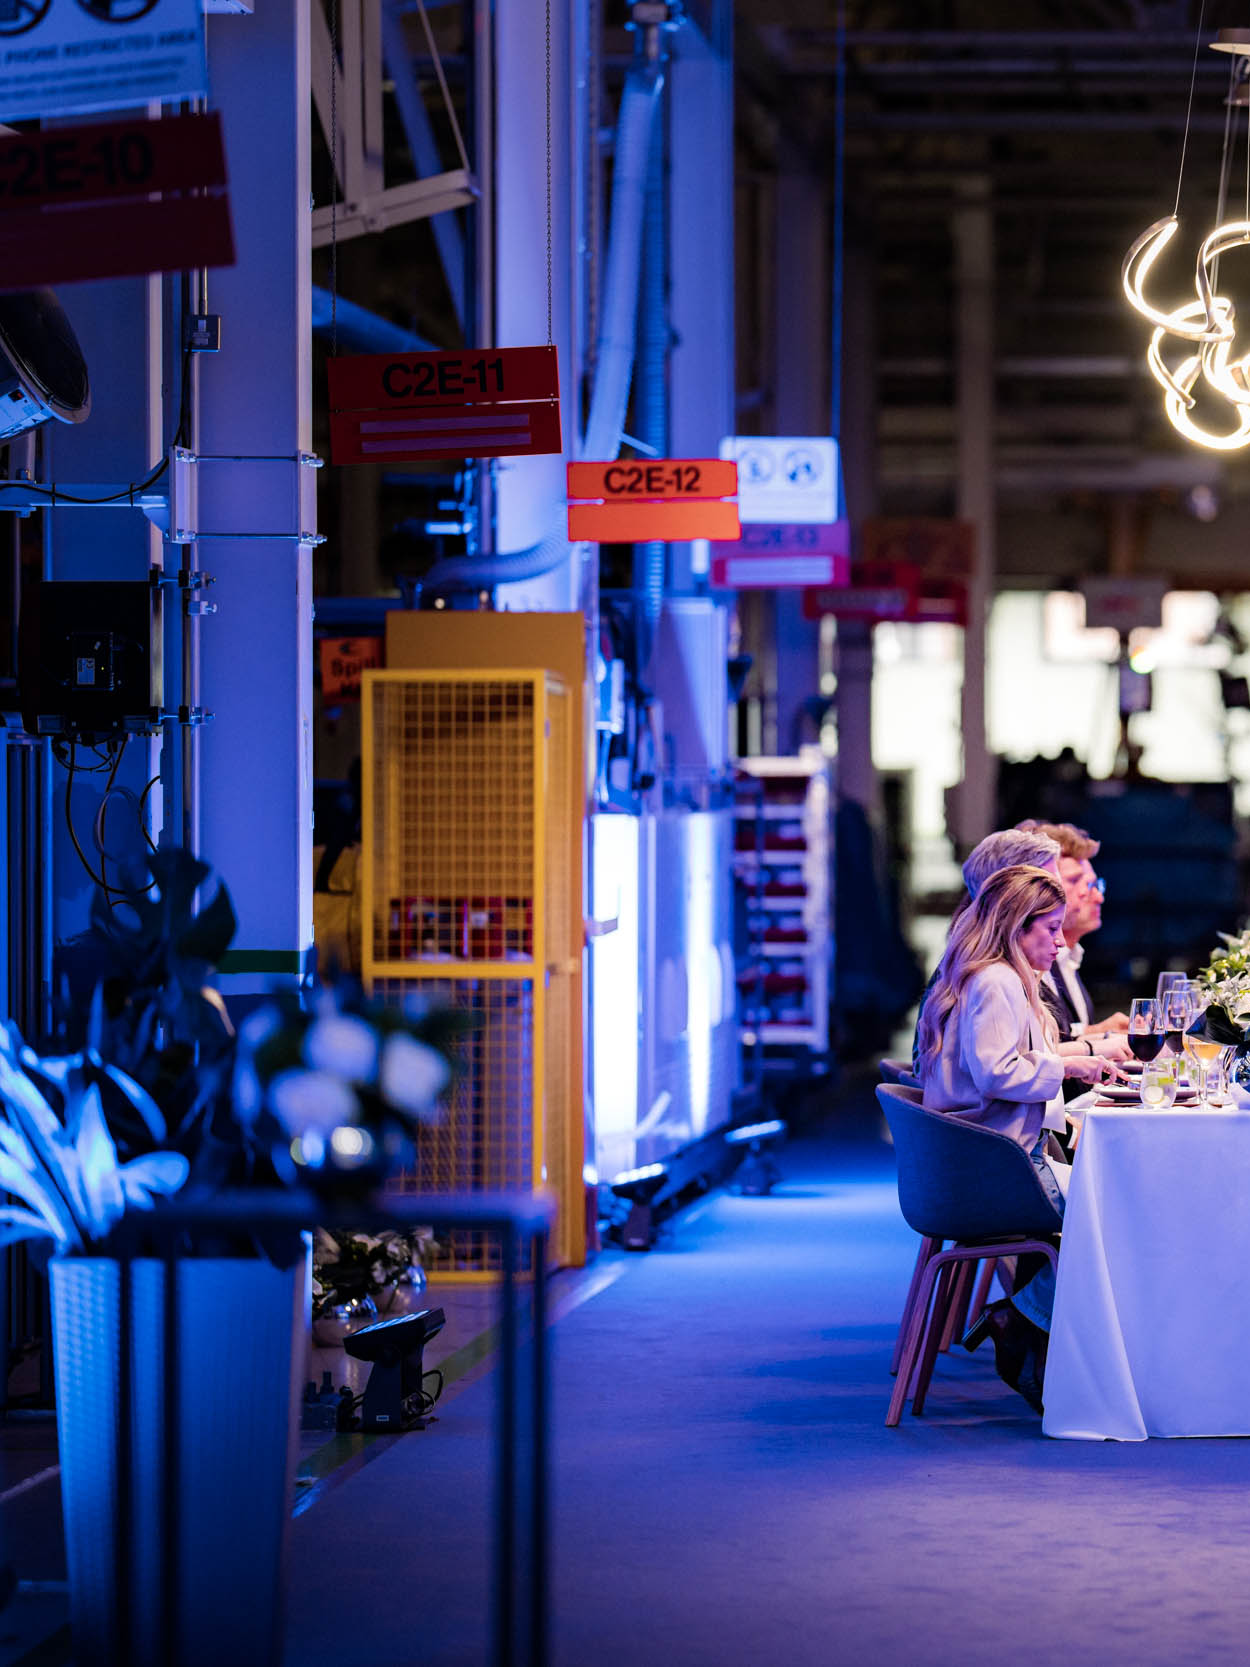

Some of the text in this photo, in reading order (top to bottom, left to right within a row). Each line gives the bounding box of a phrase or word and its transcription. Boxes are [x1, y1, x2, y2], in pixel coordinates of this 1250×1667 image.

[0, 133, 154, 197] 2E-10
[382, 358, 505, 397] C2E-11
[604, 466, 701, 494] C2E-12
